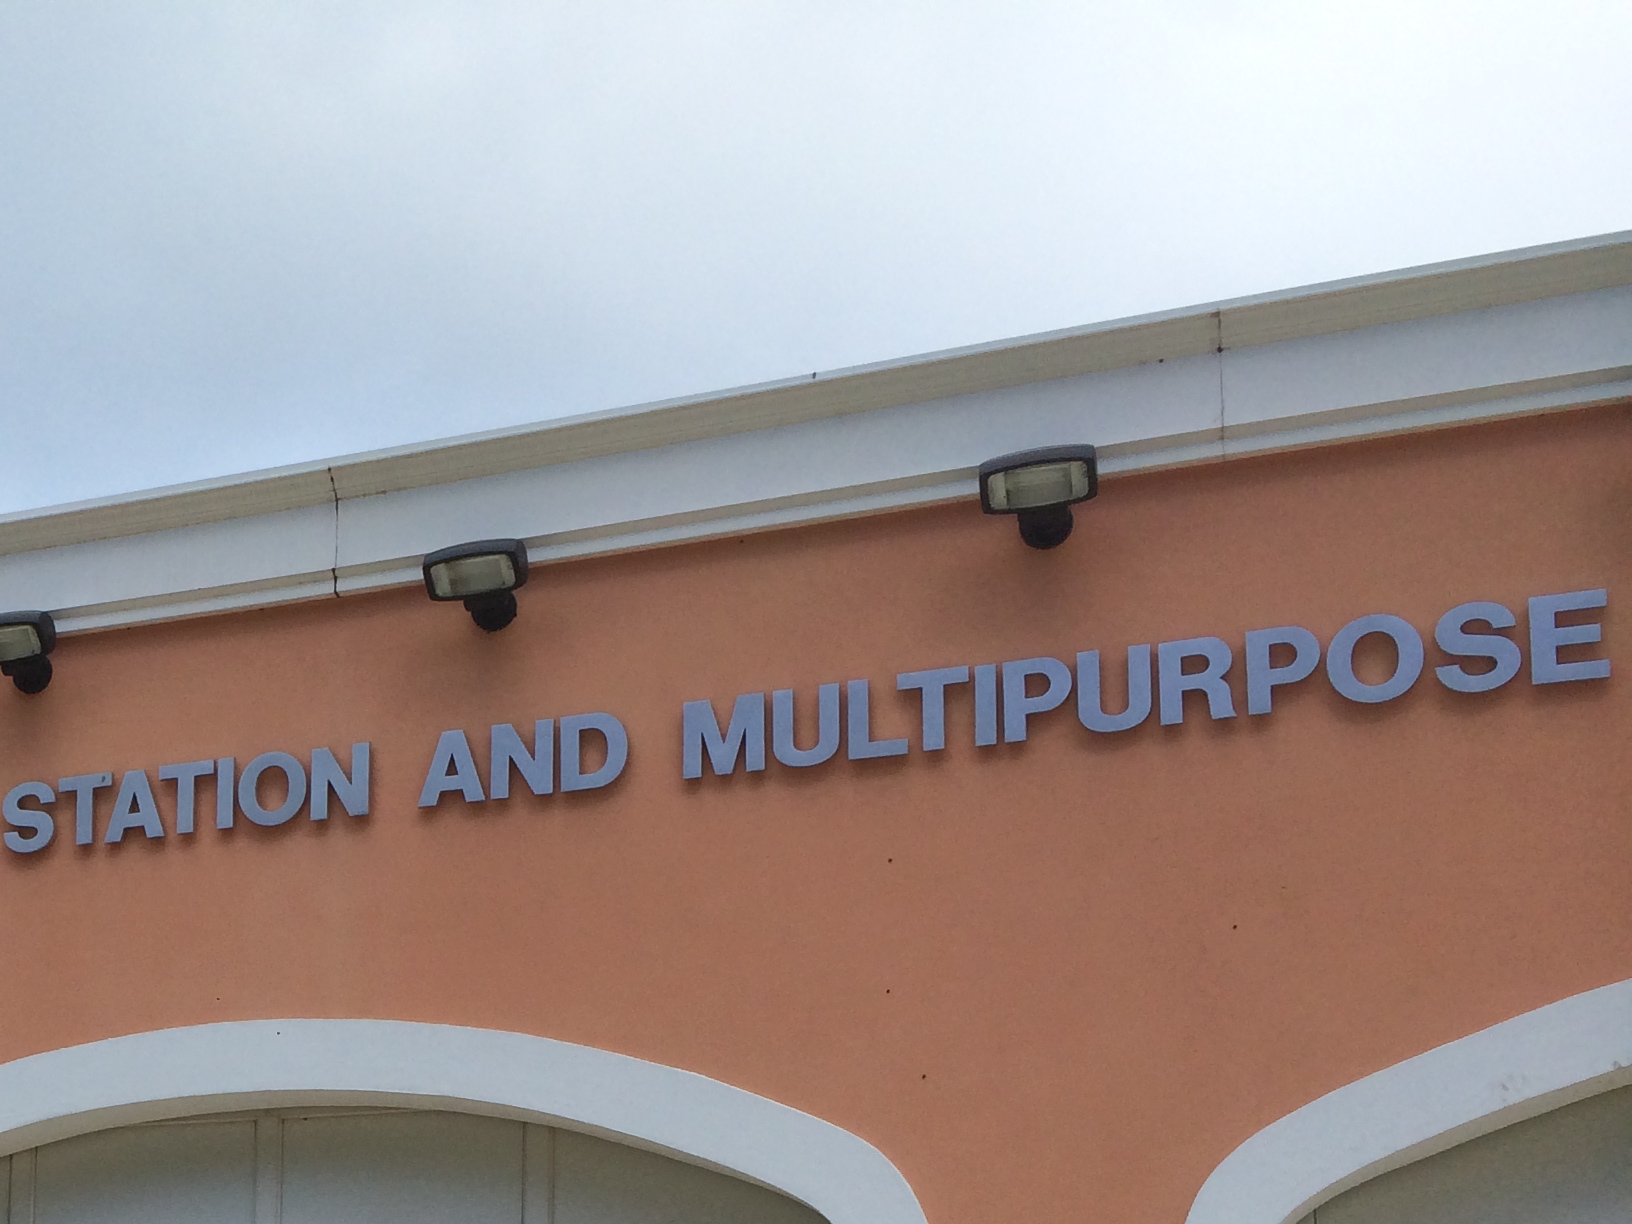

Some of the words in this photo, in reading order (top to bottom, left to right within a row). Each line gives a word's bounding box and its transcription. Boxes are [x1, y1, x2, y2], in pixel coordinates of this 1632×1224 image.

[2, 741, 370, 853] STATION
[418, 712, 628, 808] AND
[682, 588, 1611, 781] MULTIPURPOSE
